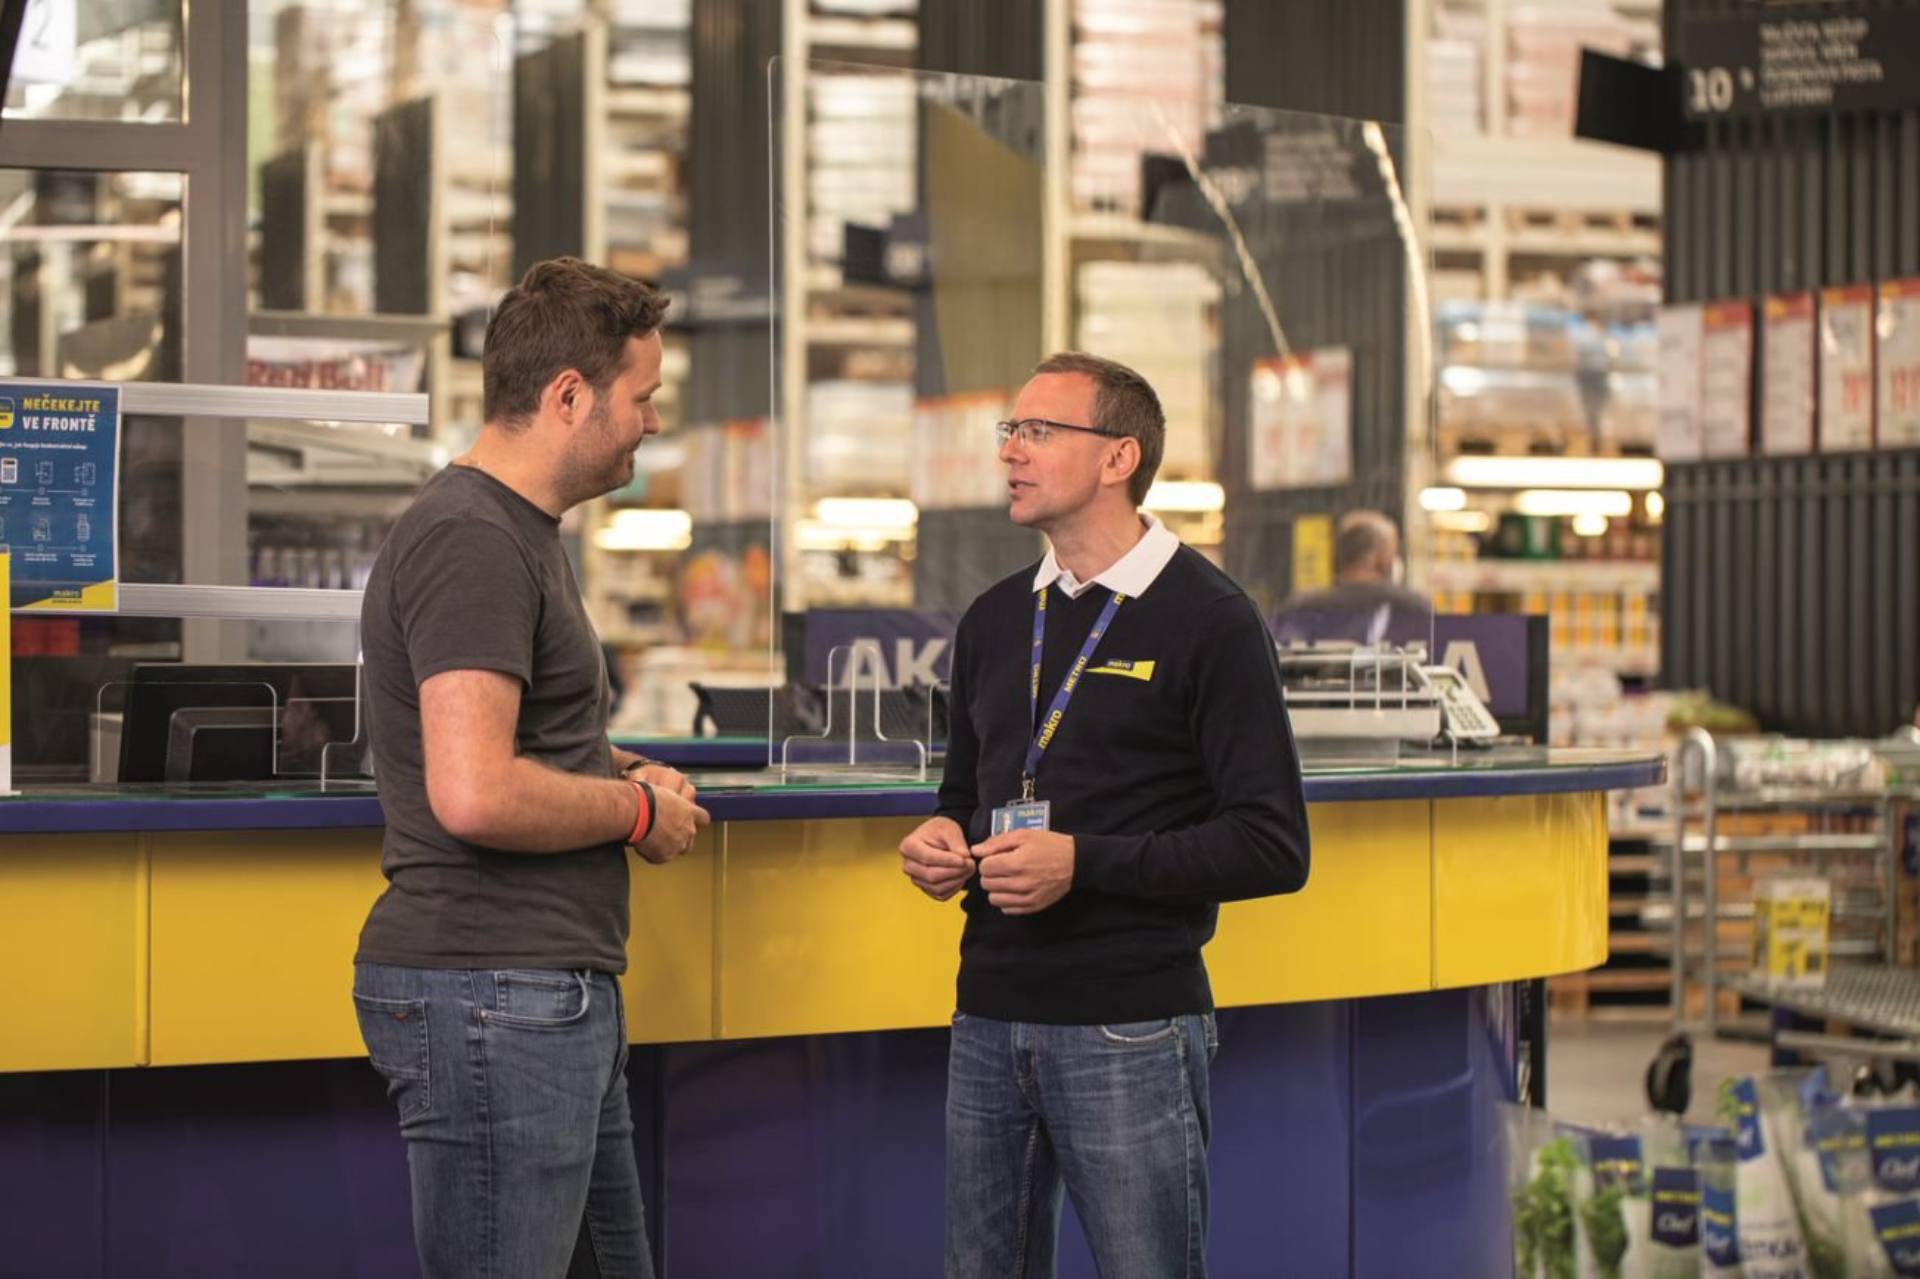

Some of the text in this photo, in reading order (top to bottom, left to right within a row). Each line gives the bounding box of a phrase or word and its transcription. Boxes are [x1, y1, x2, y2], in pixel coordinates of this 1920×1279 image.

[1689, 66, 1734, 112] 10
[22, 413, 96, 432] VE FRONTĚ
[23, 393, 101, 413] NEČEKEJTE
[1063, 655, 1088, 694] METRO
[1038, 709, 1063, 750] makro
